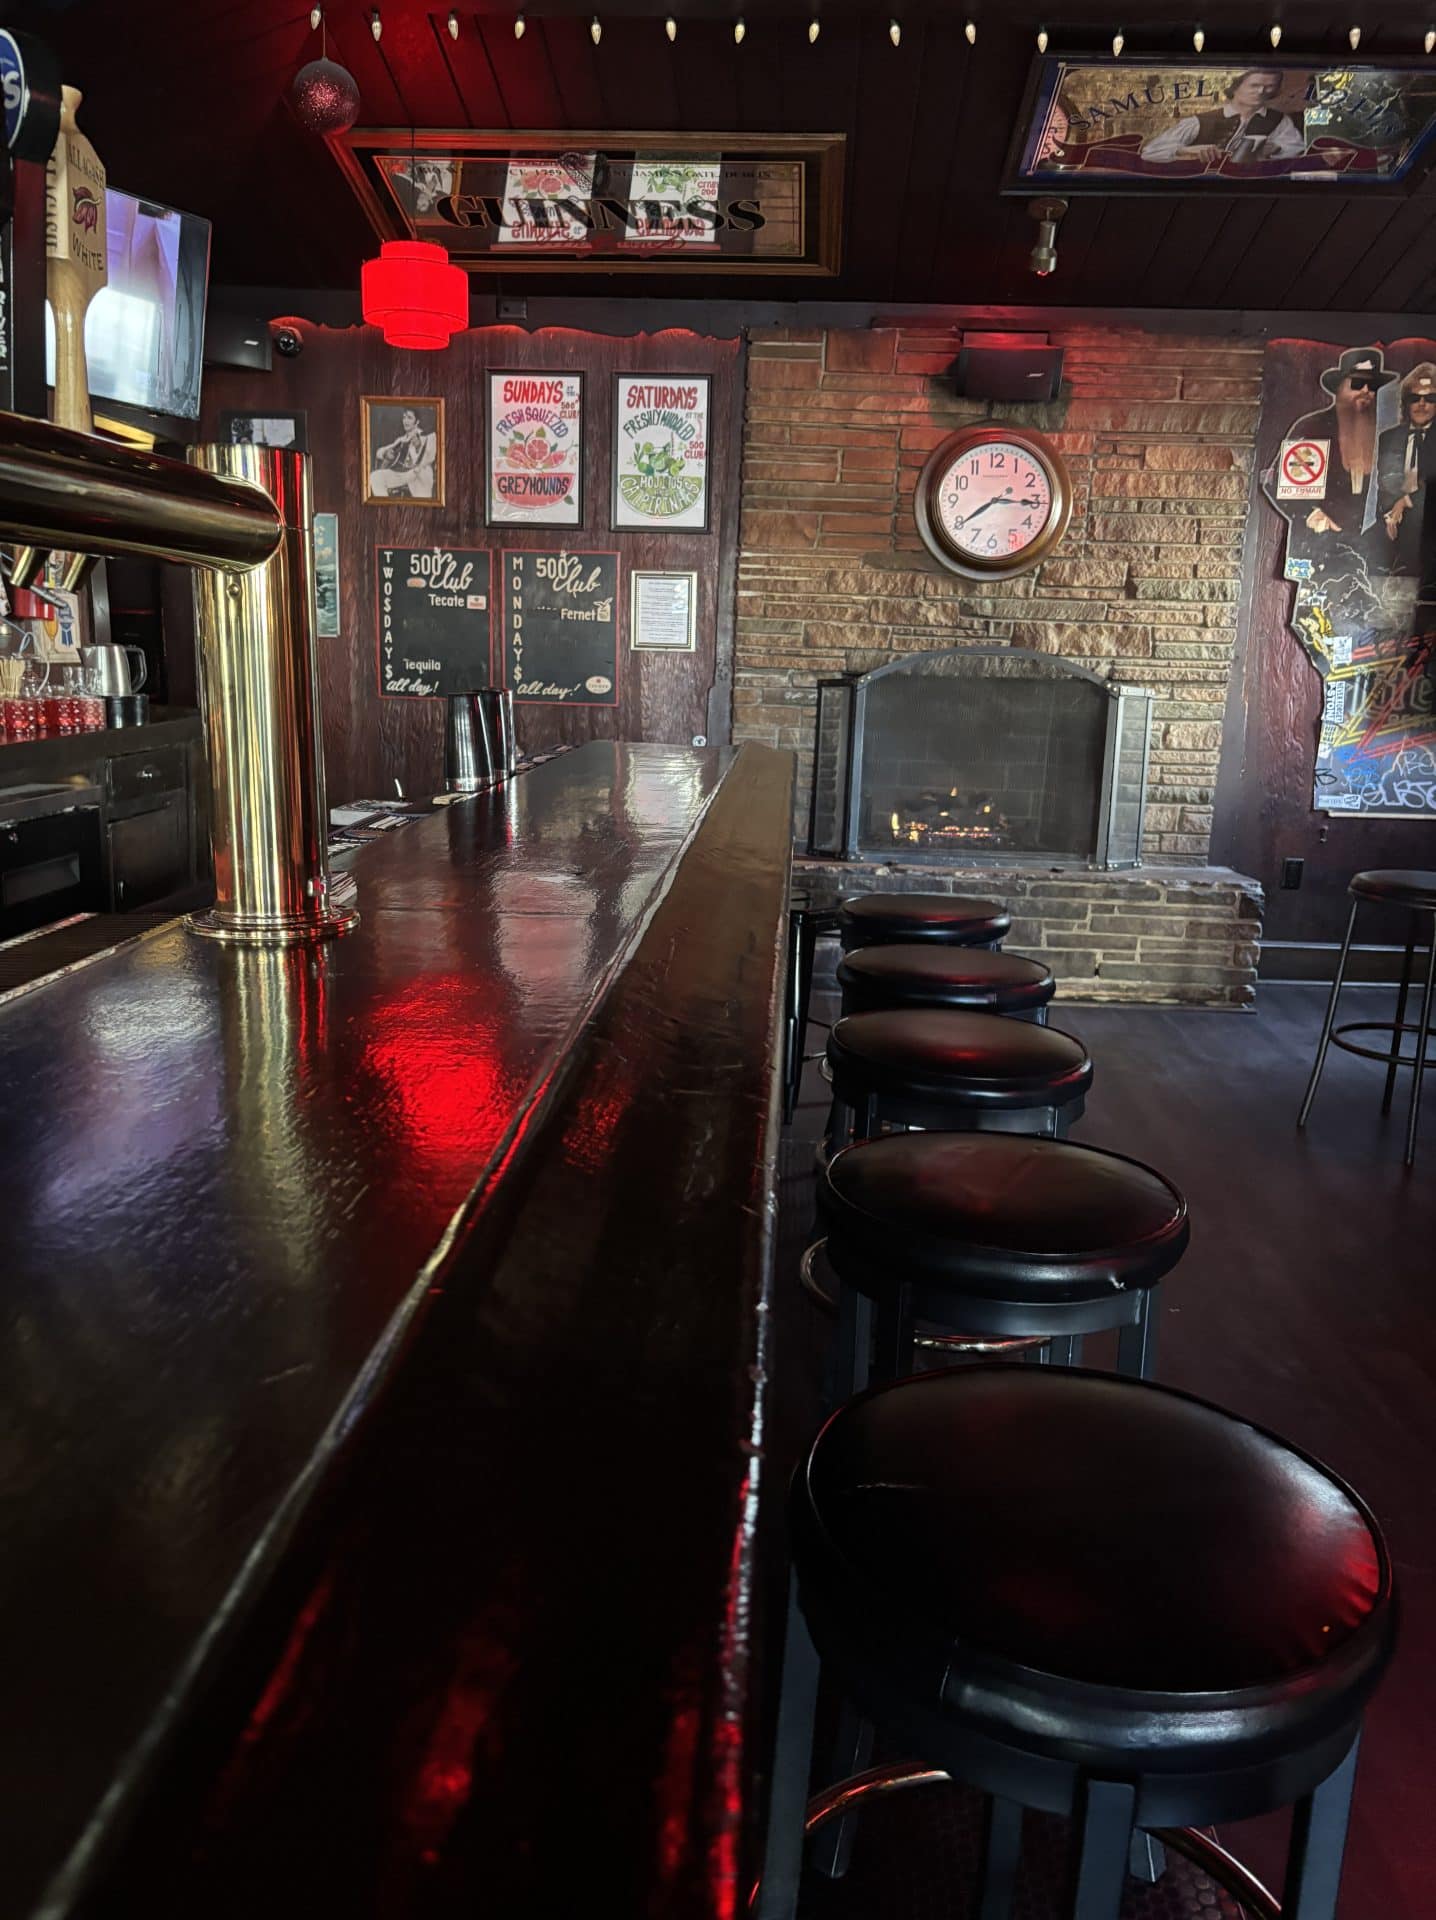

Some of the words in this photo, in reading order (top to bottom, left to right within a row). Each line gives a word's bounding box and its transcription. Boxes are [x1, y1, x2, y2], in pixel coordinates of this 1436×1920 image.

[1068, 79, 1214, 131] SAMUEL
[436, 195, 767, 231] GUINNESS
[73, 231, 104, 271] WHITE
[503, 379, 564, 404] SUNDAYS
[626, 384, 698, 410] SATURDAYS
[496, 408, 526, 437] FRESH
[524, 405, 569, 438] SQUEEZED
[622, 409, 662, 440] FRESHLY
[689, 440, 705, 449] 500
[684, 449, 704, 460] CLUB
[990, 452, 1006, 469] 12
[971, 459, 980, 476] 11
[497, 475, 570, 497] GREYHOUNDS
[955, 475, 970, 491] 10
[1024, 472, 1037, 488] 2
[948, 493, 960, 509] 9
[954, 515, 966, 531] 8
[1021, 514, 1034, 530] 4
[970, 527, 983, 544] 7
[986, 533, 998, 550] 6
[1008, 528, 1018, 545] 5
[410, 553, 442, 576] 500
[428, 552, 474, 594] Club
[536, 557, 569, 580] 500
[552, 556, 602, 599] Club
[428, 593, 465, 608] Tecate
[560, 608, 596, 622] Fernet
[402, 657, 441, 676] Tequila
